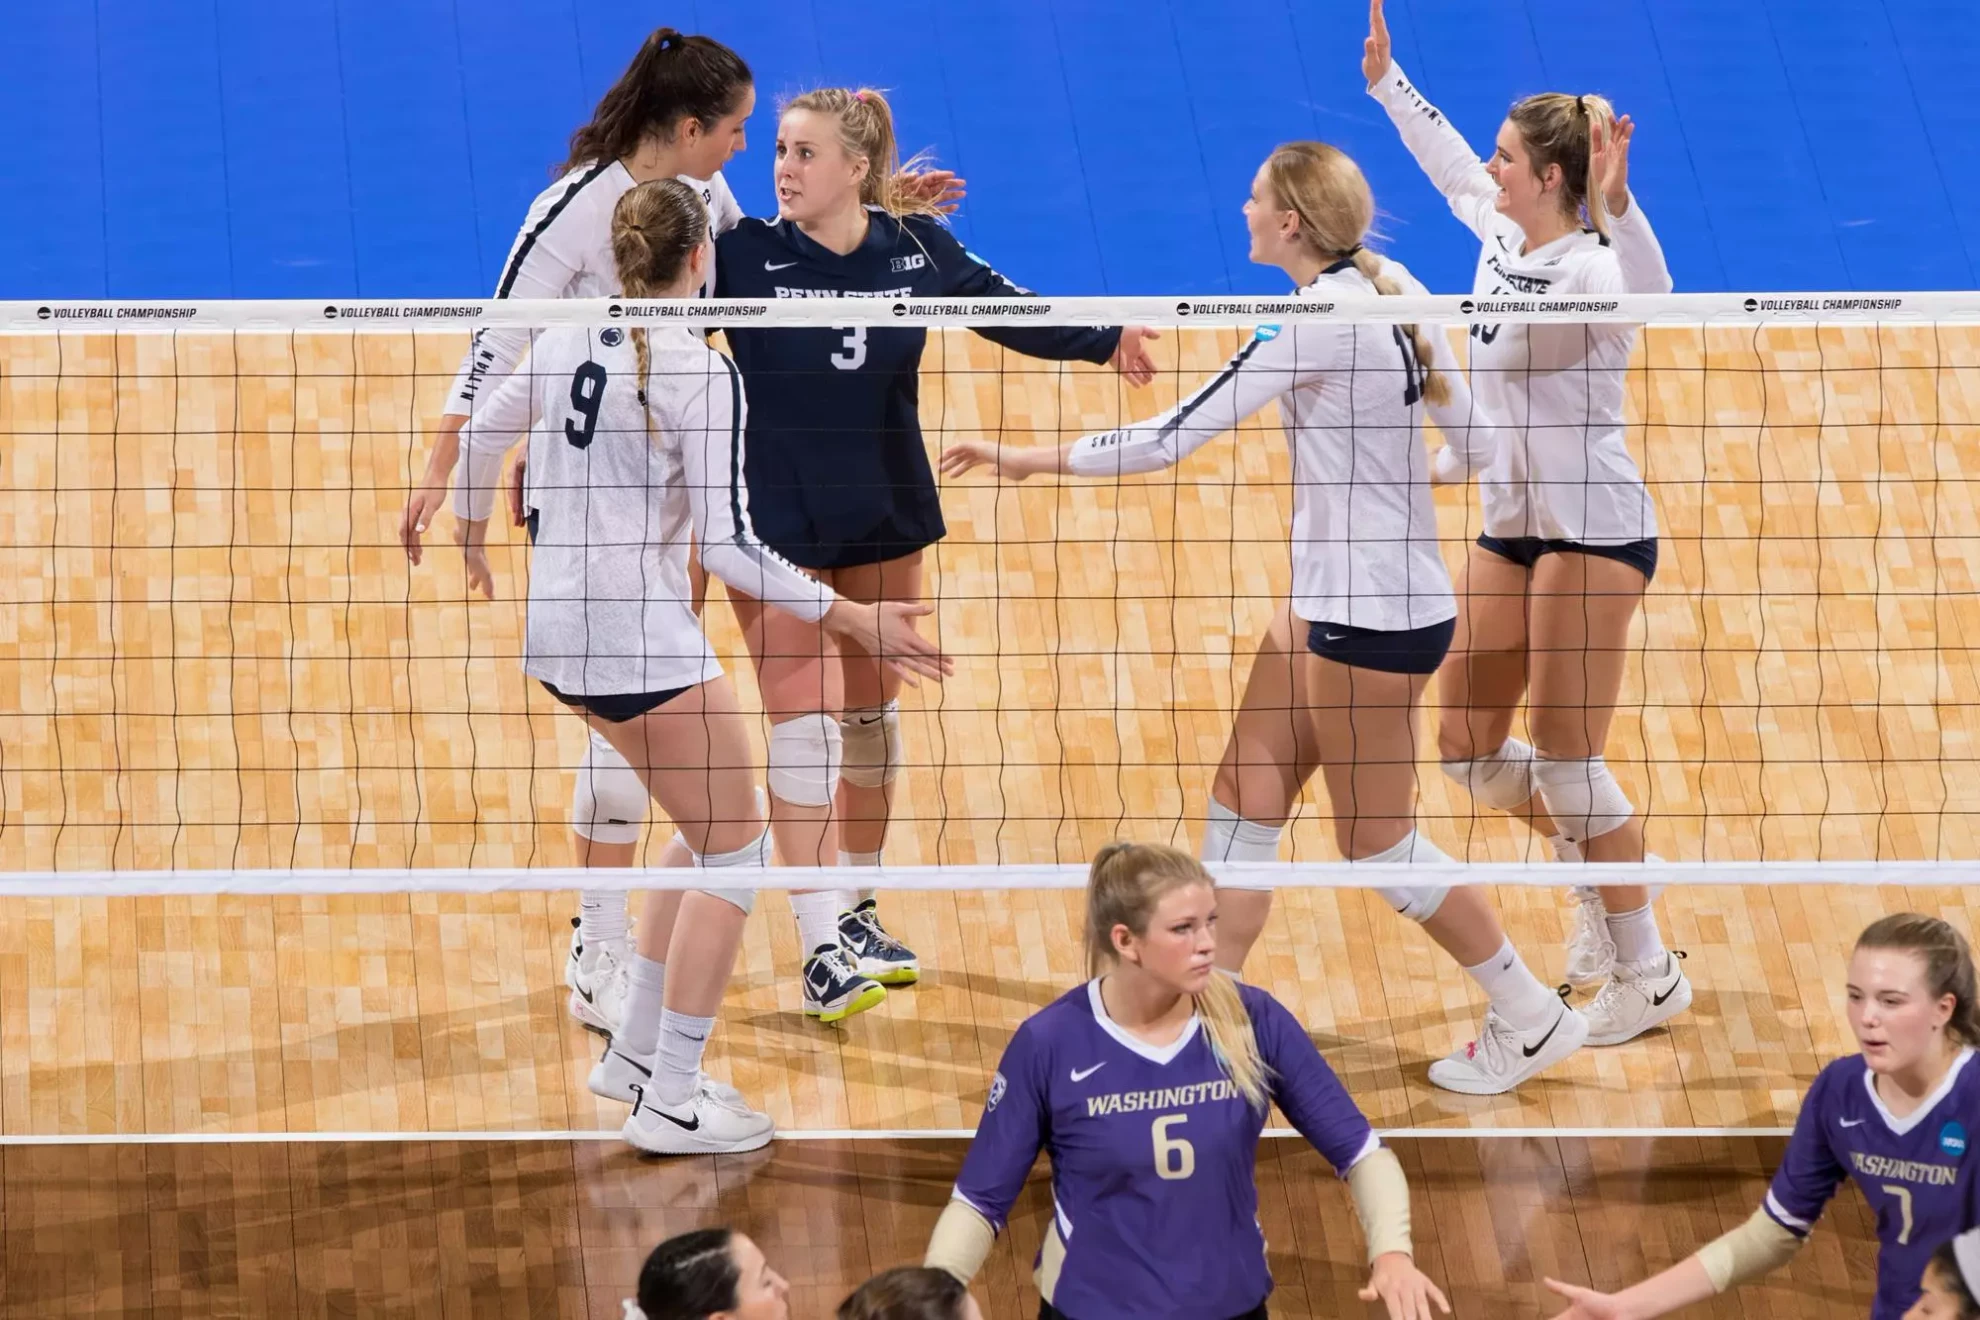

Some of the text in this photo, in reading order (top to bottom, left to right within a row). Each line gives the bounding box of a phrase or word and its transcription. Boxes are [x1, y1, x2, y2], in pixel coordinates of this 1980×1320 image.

[625, 306, 685, 317] VOLLEYBALL
[688, 305, 767, 317] CHAMPIONSHIP
[909, 305, 968, 316] VOLLEYBALL
[971, 304, 1051, 316] CHAMPIONSHIP
[1193, 304, 1252, 315] VOLLEYBALL
[1255, 303, 1335, 315] CHAMPIONSHIP
[1477, 302, 1536, 313] VOLLEYBALL
[1538, 301, 1619, 313] CHAMPIONSHIP
[1761, 300, 1820, 311] VOLLEYBALL
[1822, 299, 1902, 311] CHAMPIONSHIP
[53, 308, 113, 319] VOLLEYBALL
[117, 308, 197, 318] CHAMPIONSHIP
[340, 307, 400, 318] VOLLEYBALL
[403, 307, 483, 318] CHAMPIONSHIP
[831, 326, 867, 370] 3
[565, 360, 607, 450] 9
[1087, 1079, 1239, 1117] WASHINGTON
[1152, 1113, 1195, 1180] 6
[1882, 1184, 1913, 1245] 7
